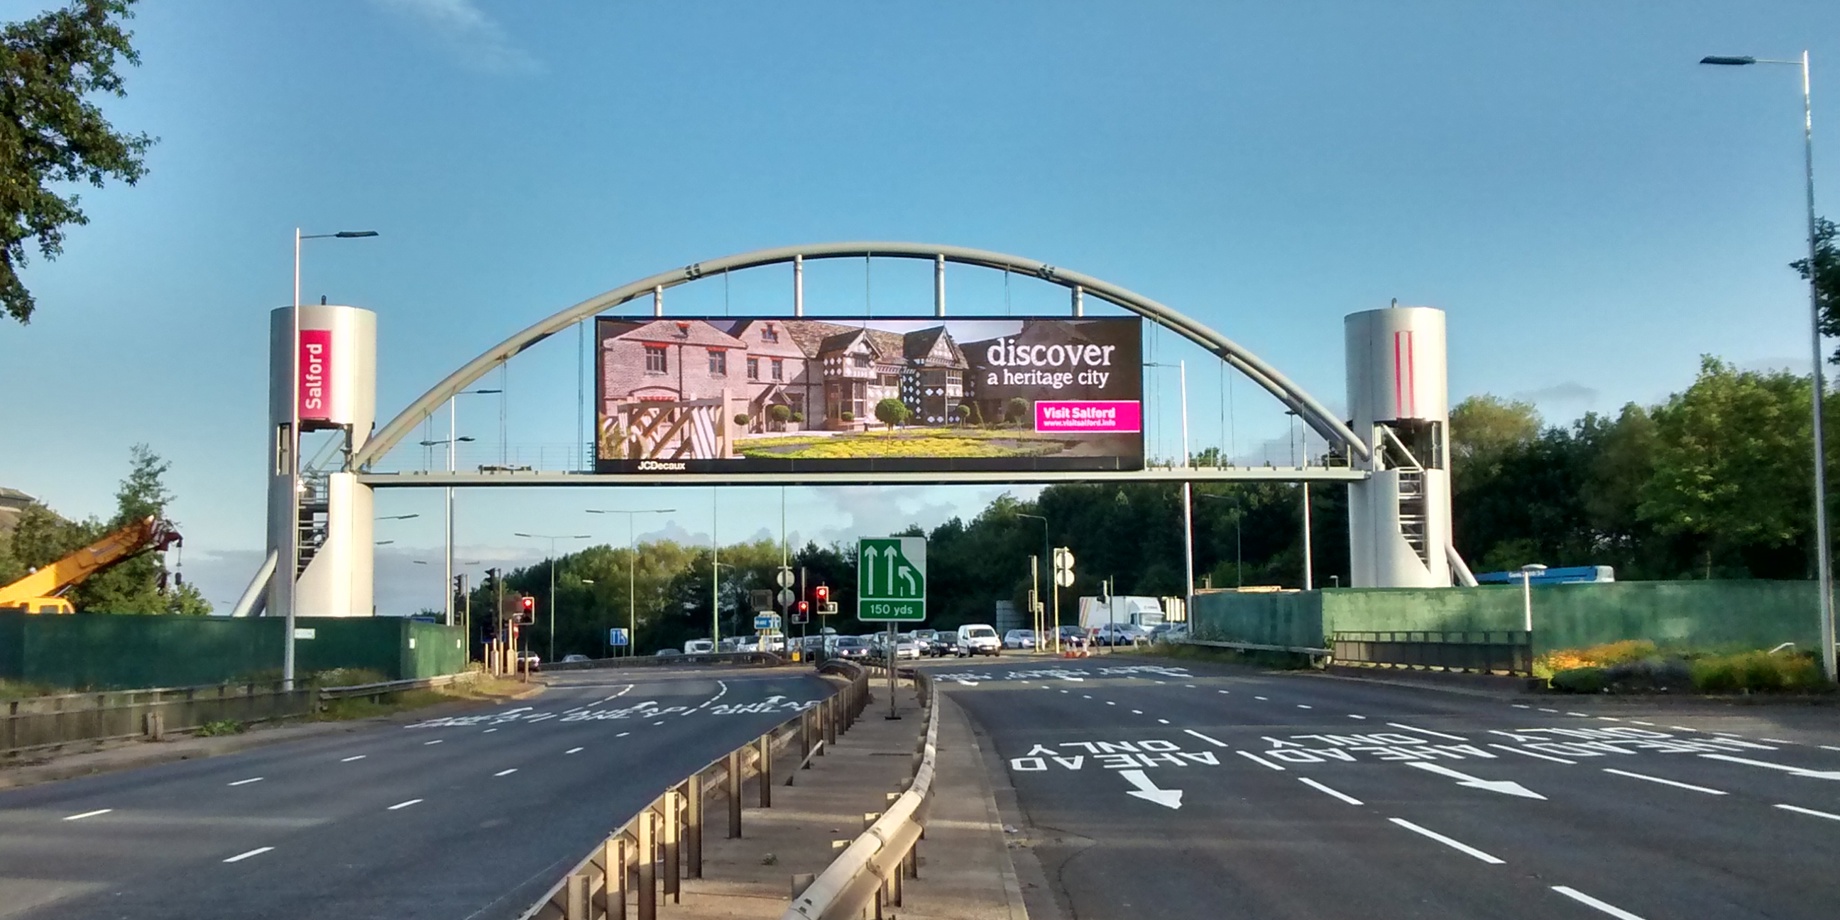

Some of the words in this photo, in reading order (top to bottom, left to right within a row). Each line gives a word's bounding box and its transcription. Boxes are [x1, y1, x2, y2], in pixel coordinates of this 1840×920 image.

[987, 338, 1115, 366] discover
[305, 343, 322, 409] Salford
[987, 372, 998, 385] a
[1003, 369, 1073, 389] heritage
[1078, 370, 1109, 389] city
[1043, 407, 1070, 419] Visit
[1072, 407, 1116, 419] Salford
[1043, 419, 1116, 427] www.visitsalford.info
[638, 461, 685, 470] JCDecaux
[870, 604, 890, 614] 150
[894, 604, 913, 616] yds
[1027, 740, 1181, 756] ONLY
[1261, 733, 1428, 747] ONLY
[1010, 751, 1220, 771] AHEAD
[1265, 744, 1498, 762] AHEAD
